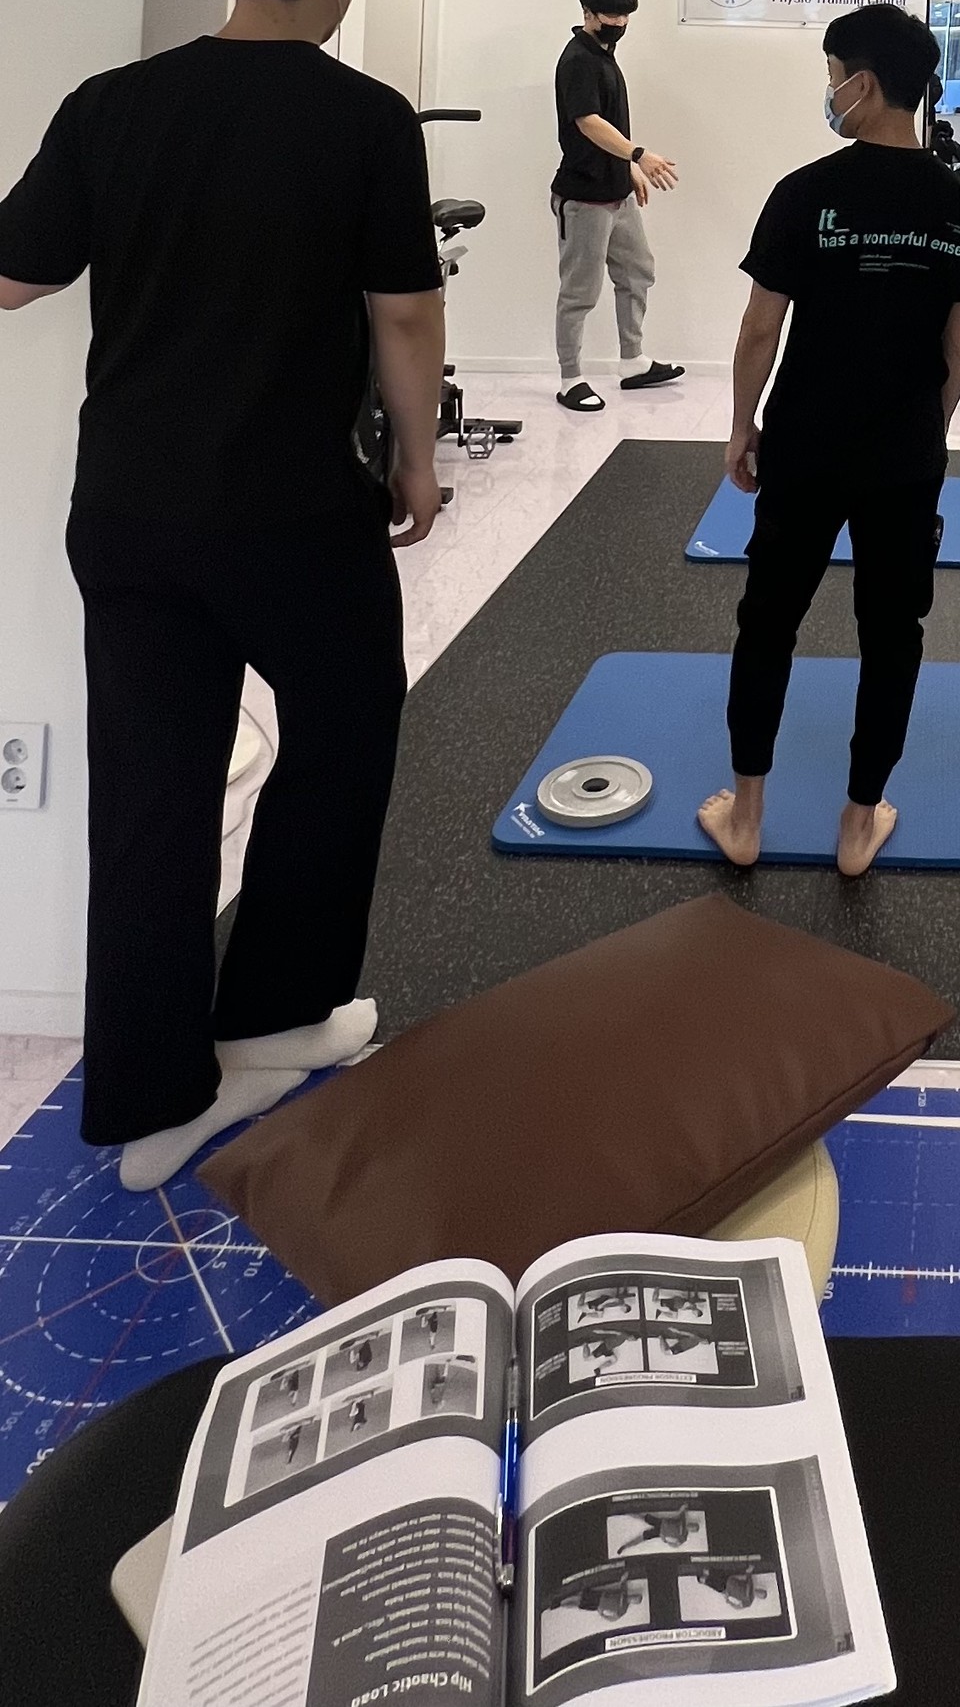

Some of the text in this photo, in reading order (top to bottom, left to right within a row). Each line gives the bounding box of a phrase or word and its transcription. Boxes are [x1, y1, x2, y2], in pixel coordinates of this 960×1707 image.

[818, 234, 846, 249] has
[849, 234, 858, 245] a
[212, 1261, 225, 1269] 5
[243, 1260, 262, 1278] 10
[351, 1671, 472, 1707] Hip Chaotic Load
